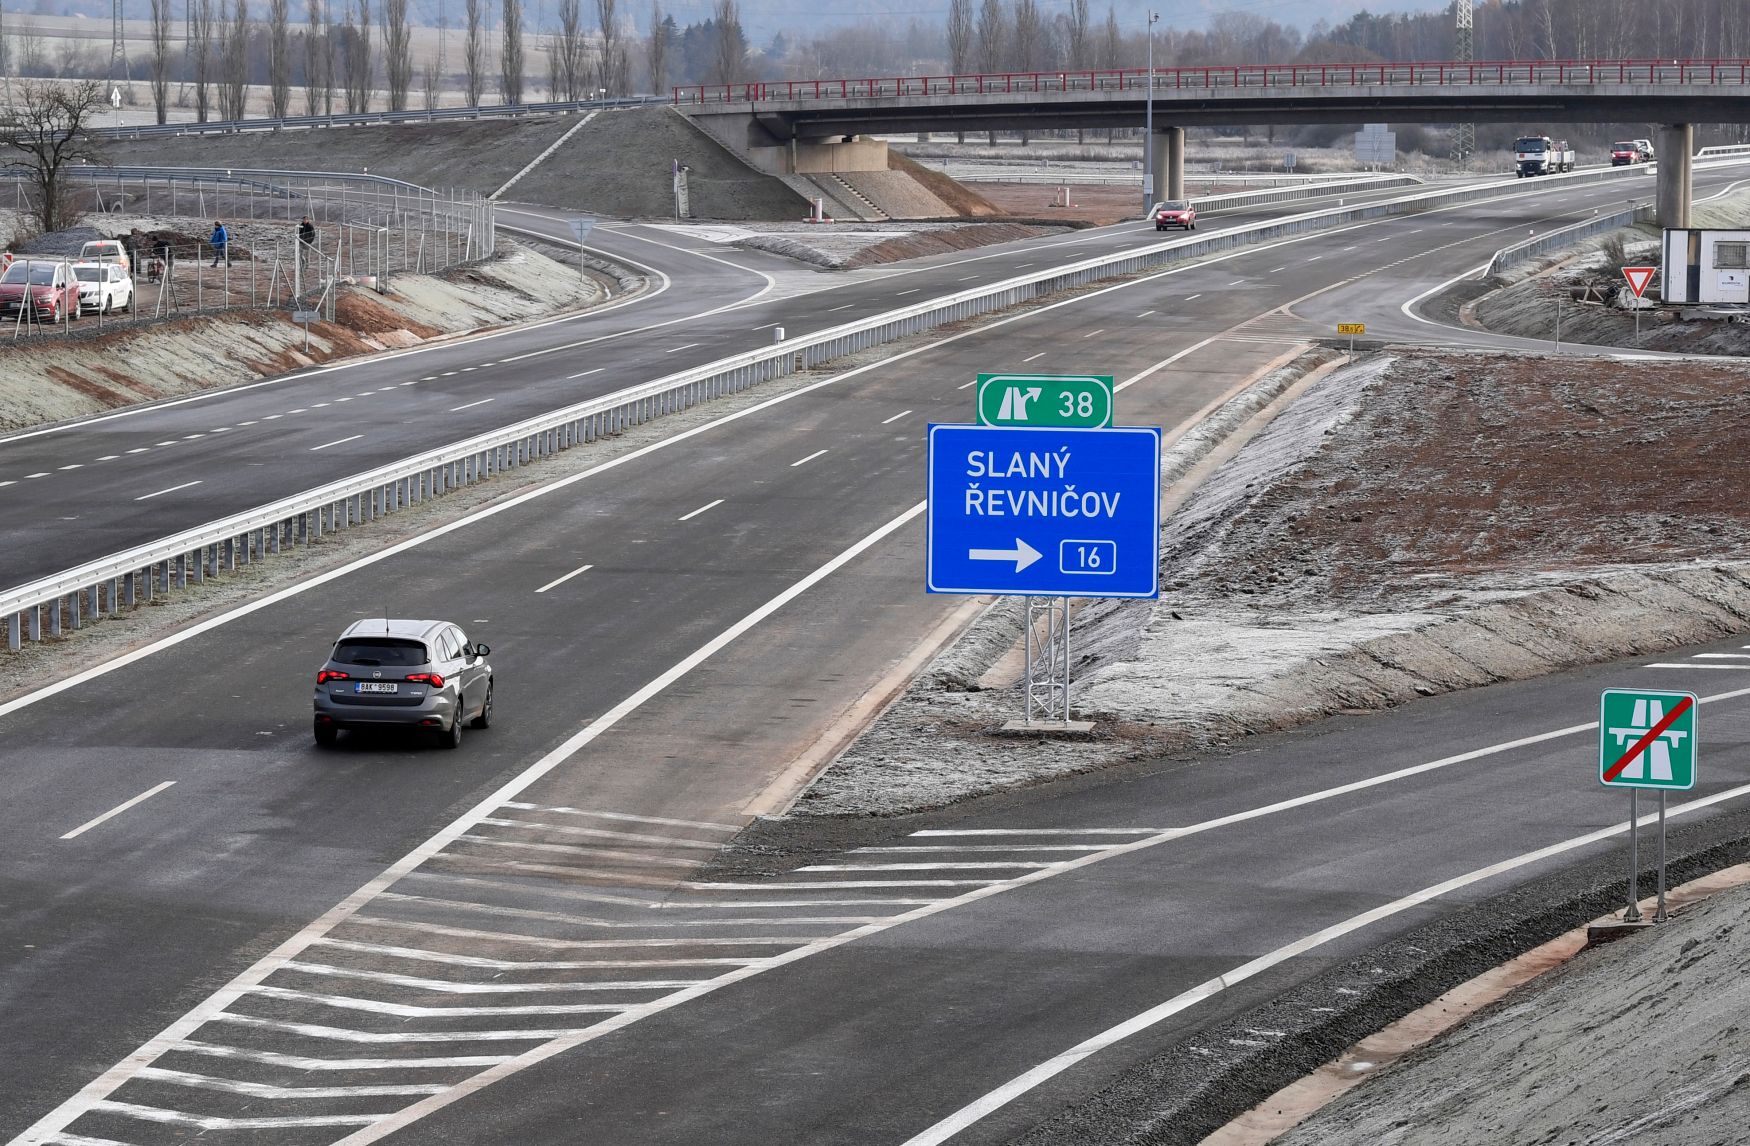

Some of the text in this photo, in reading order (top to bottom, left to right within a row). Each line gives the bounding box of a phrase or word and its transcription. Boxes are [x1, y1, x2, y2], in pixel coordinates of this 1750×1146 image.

[1058, 391, 1093, 418] 38
[966, 446, 1071, 478] SLANÝ
[965, 483, 1121, 518] ŘEVNIČOV
[1077, 547, 1101, 568] 16
[361, 683, 373, 691] 8AK
